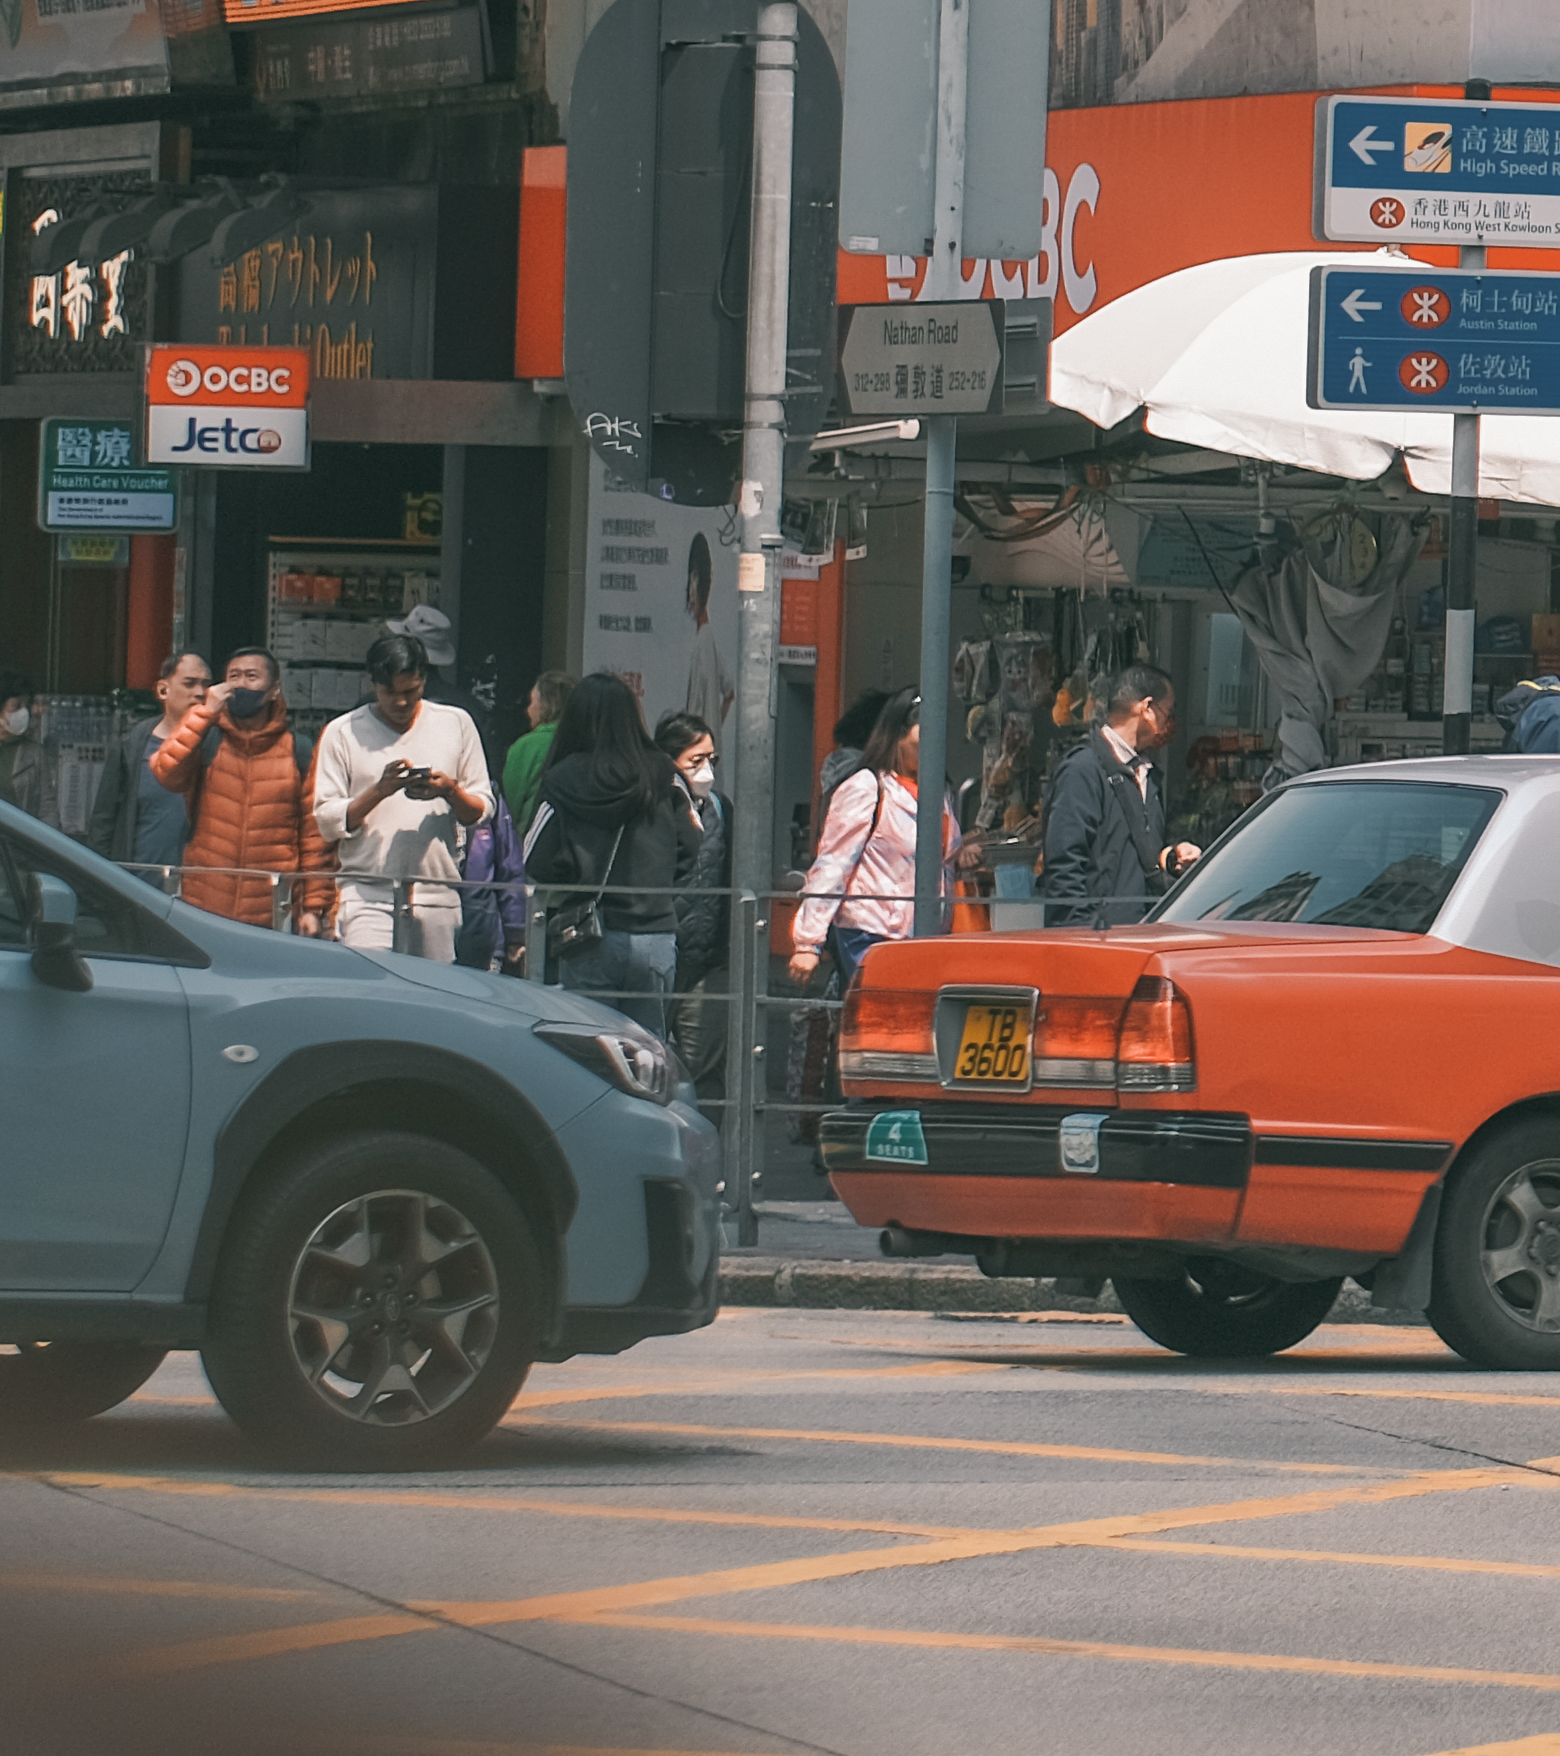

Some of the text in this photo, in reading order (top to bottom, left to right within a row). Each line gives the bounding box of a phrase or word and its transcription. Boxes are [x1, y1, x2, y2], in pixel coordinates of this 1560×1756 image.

[1460, 158, 1496, 176] High
[1500, 160, 1548, 178] Speed
[1411, 197, 1532, 221] 香港西九龍站
[1410, 218, 1440, 232] Hong
[1443, 219, 1472, 234] Kong
[1474, 220, 1502, 233] West
[1503, 220, 1552, 234] Kowloon
[1459, 288, 1558, 316] 柯士甸站
[883, 317, 959, 346] Nathan Road
[1458, 318, 1538, 331] Austin Station
[1458, 353, 1532, 381] 佐敦站
[203, 366, 291, 394] OCBC
[1457, 382, 1538, 396] Jordan Station
[53, 474, 169, 490] Health Care Voucher
[988, 1008, 1018, 1043] TB
[960, 1044, 1025, 1078] 3600
[888, 1122, 902, 1143] 4
